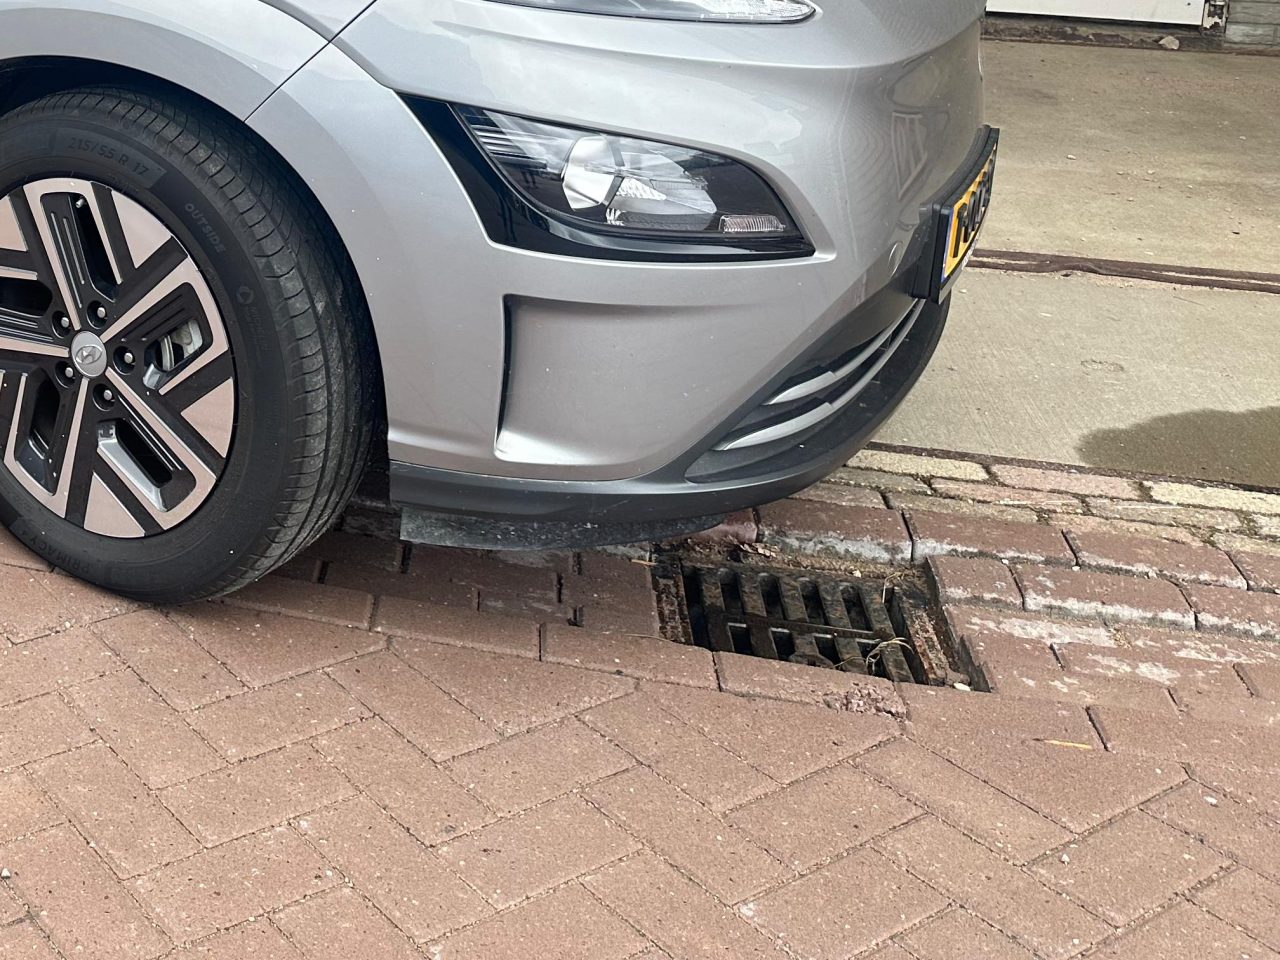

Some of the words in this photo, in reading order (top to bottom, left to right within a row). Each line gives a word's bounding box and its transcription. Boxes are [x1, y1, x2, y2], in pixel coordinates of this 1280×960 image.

[67, 136, 115, 159] 215/55
[117, 153, 129, 167] R
[132, 161, 150, 177] 17
[183, 202, 227, 254] OUTSIDE
[28, 535, 91, 575] PRIMACY
